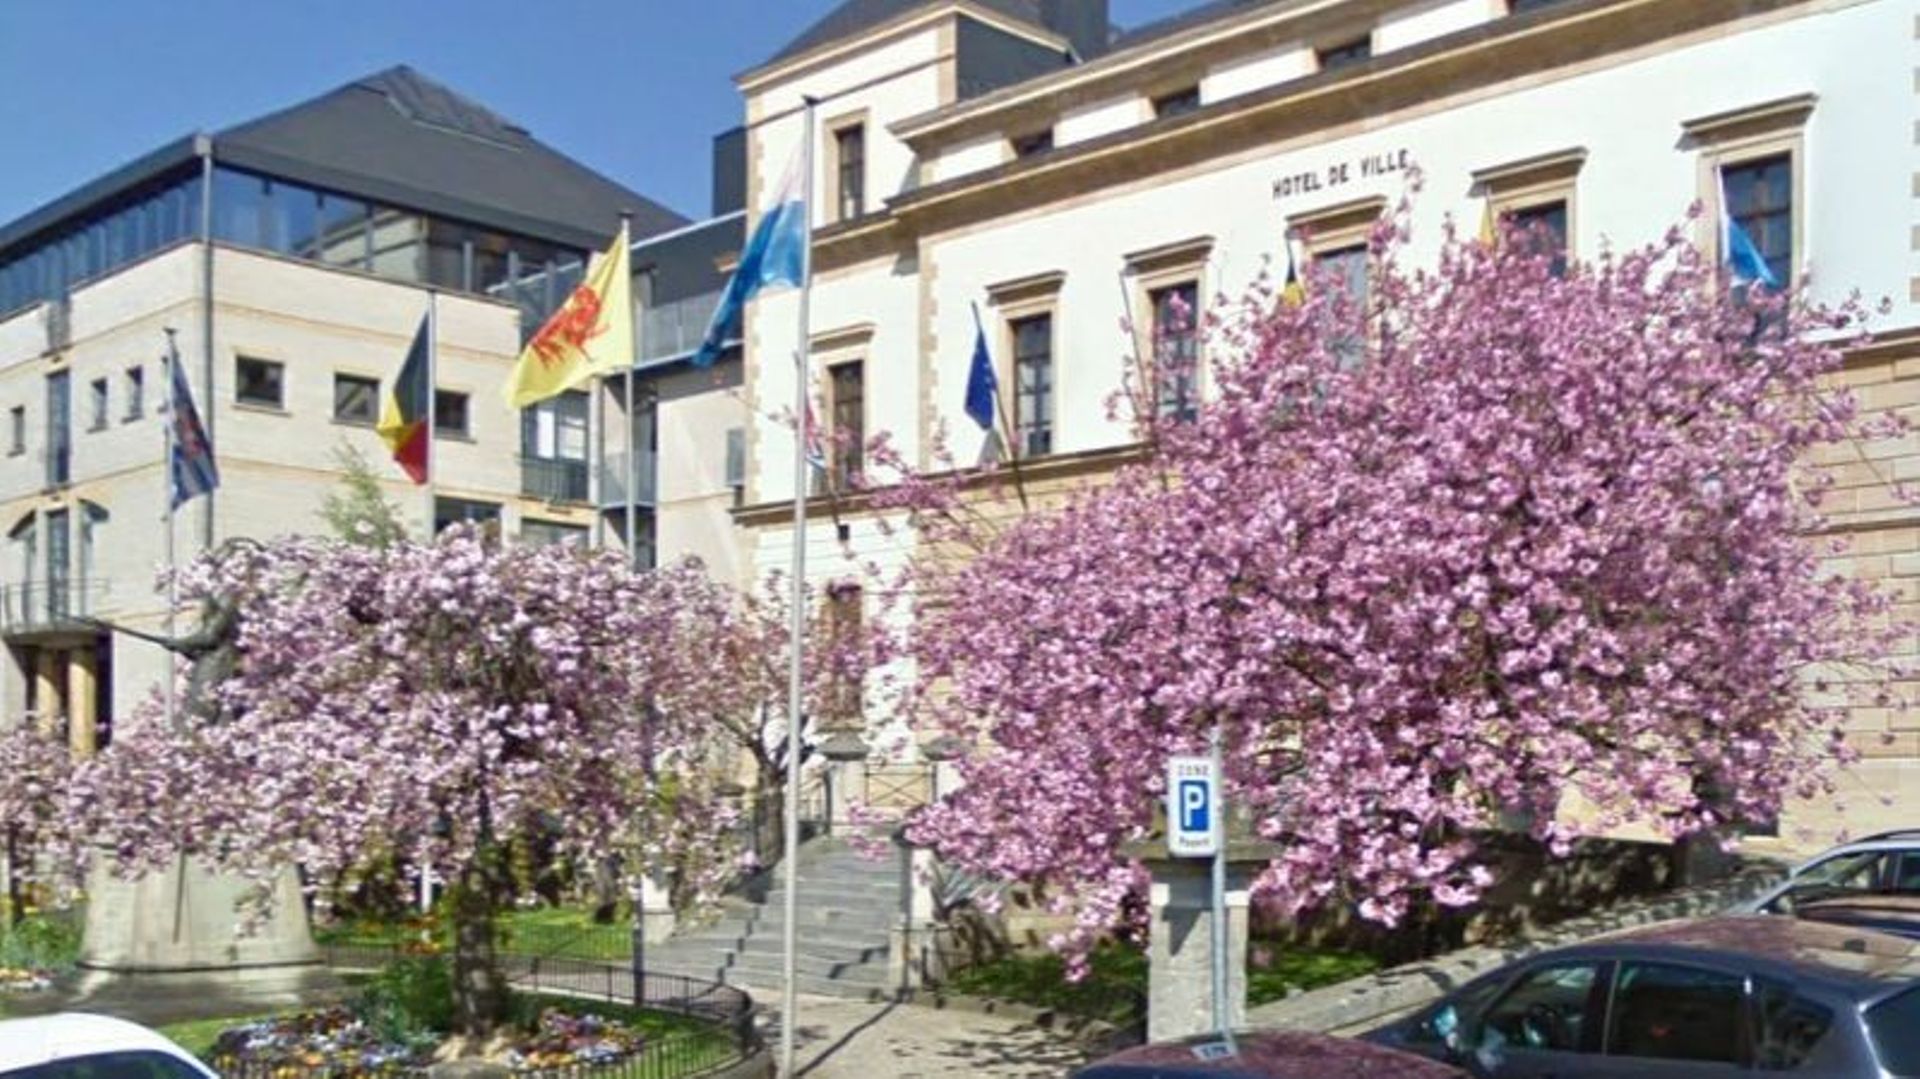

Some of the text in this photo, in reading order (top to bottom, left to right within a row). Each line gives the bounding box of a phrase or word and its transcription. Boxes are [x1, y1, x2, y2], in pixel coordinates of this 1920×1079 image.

[1273, 148, 1408, 198] HOTEL DE VILLE
[1184, 785, 1204, 827] P
